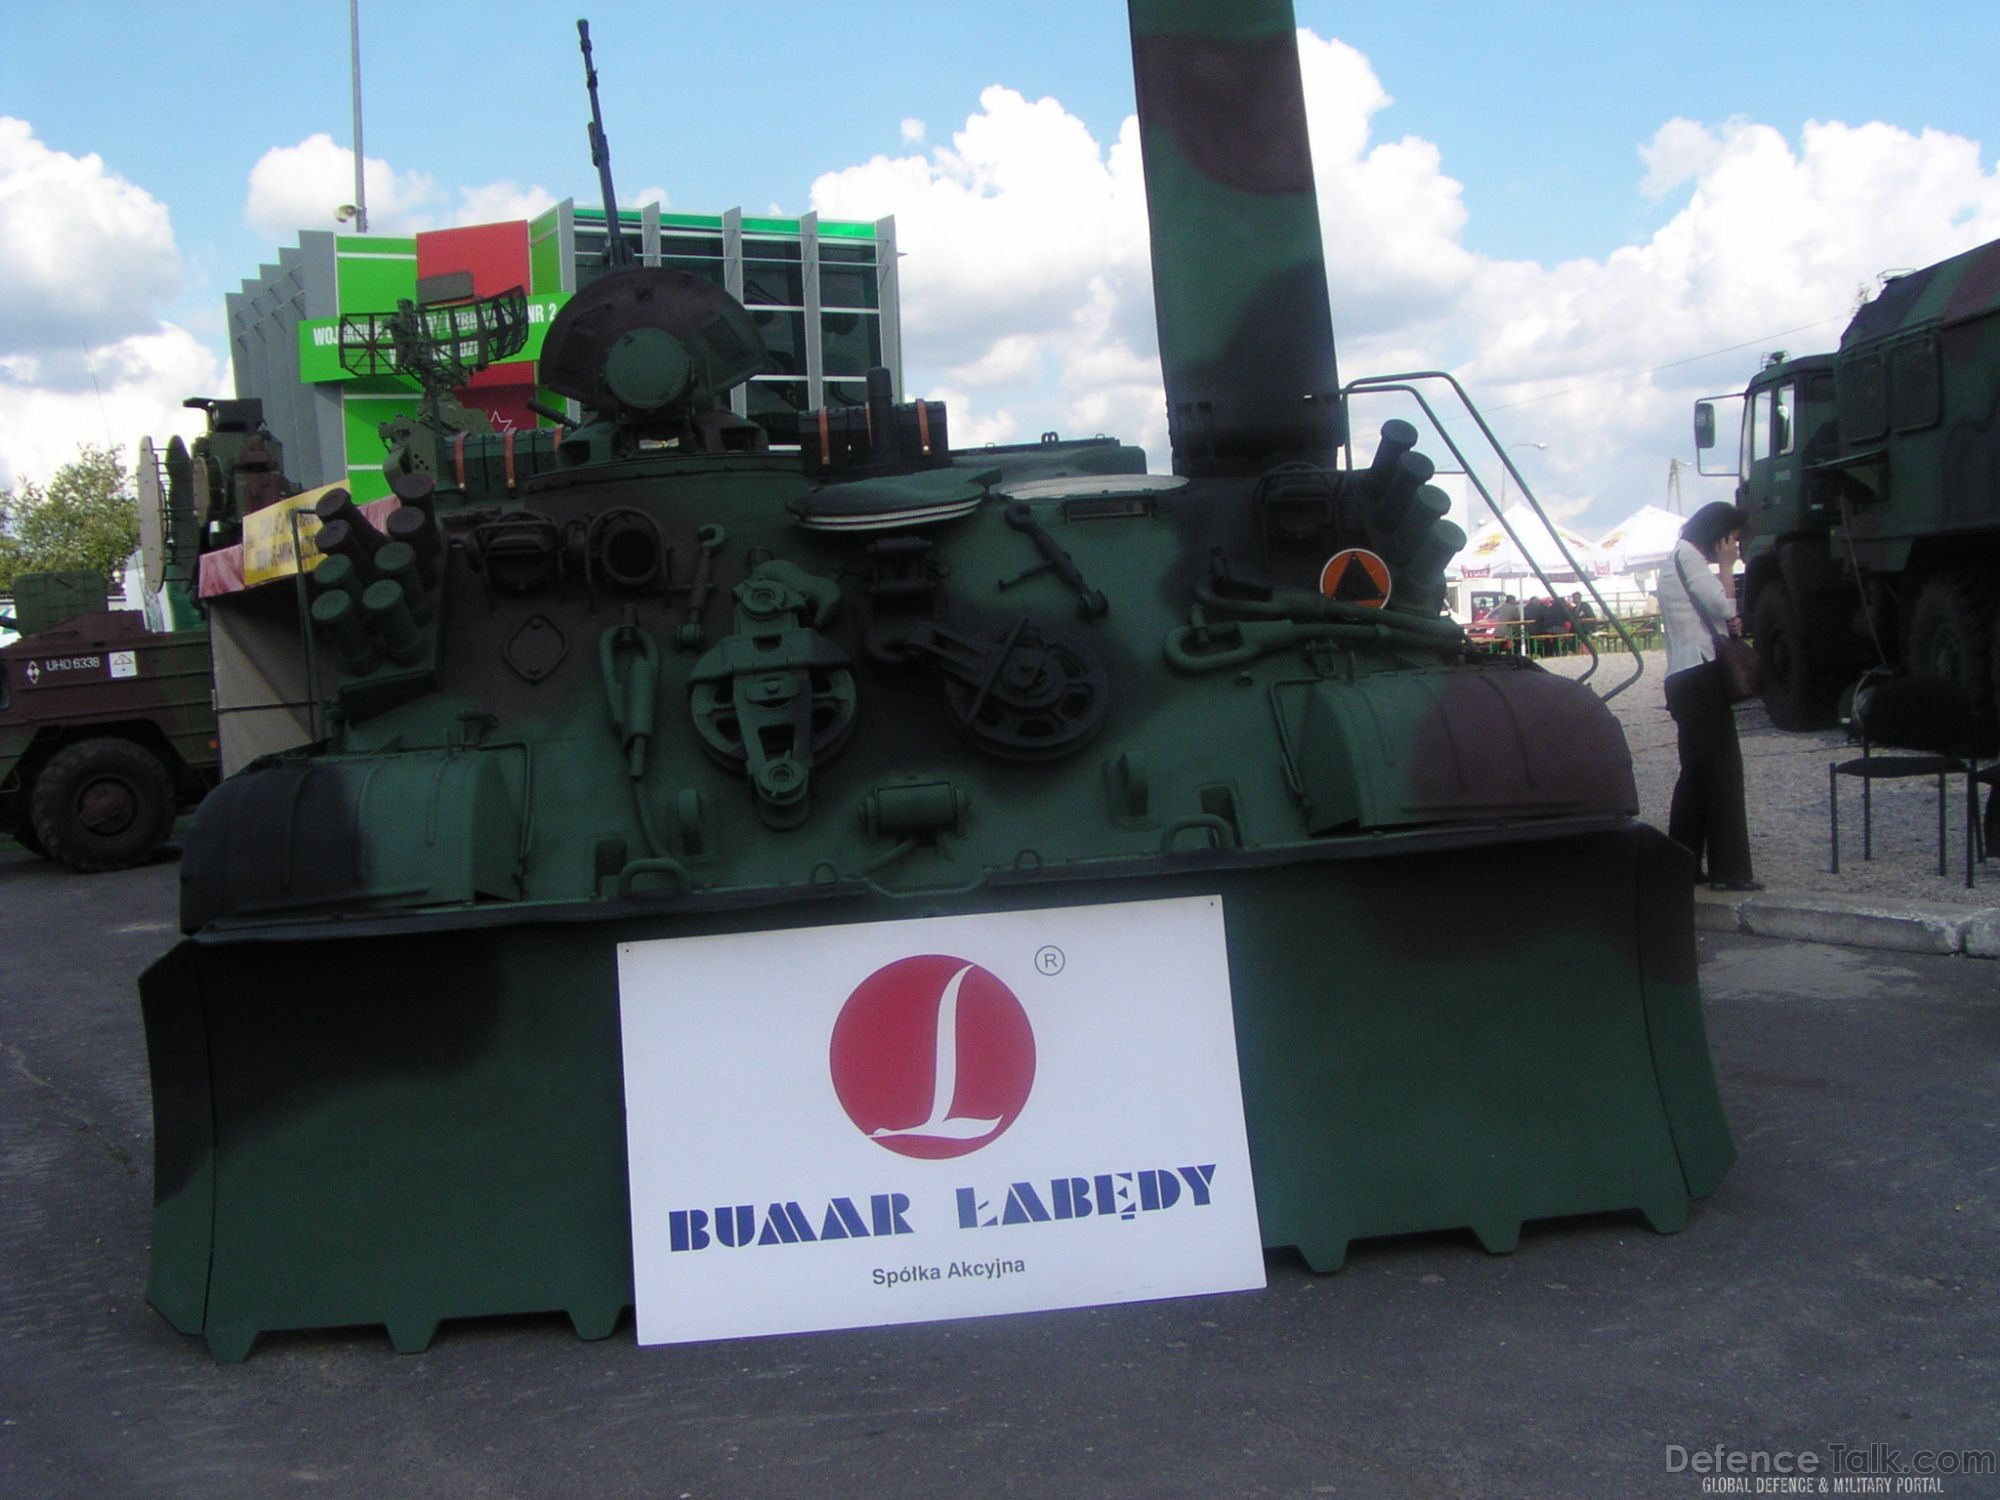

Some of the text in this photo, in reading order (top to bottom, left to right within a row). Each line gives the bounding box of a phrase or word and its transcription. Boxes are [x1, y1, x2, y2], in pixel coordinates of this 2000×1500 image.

[668, 1163, 1217, 1253] BUMAR ŁABĘDY
[872, 1257, 1026, 1288] Spółka Akcyjna
